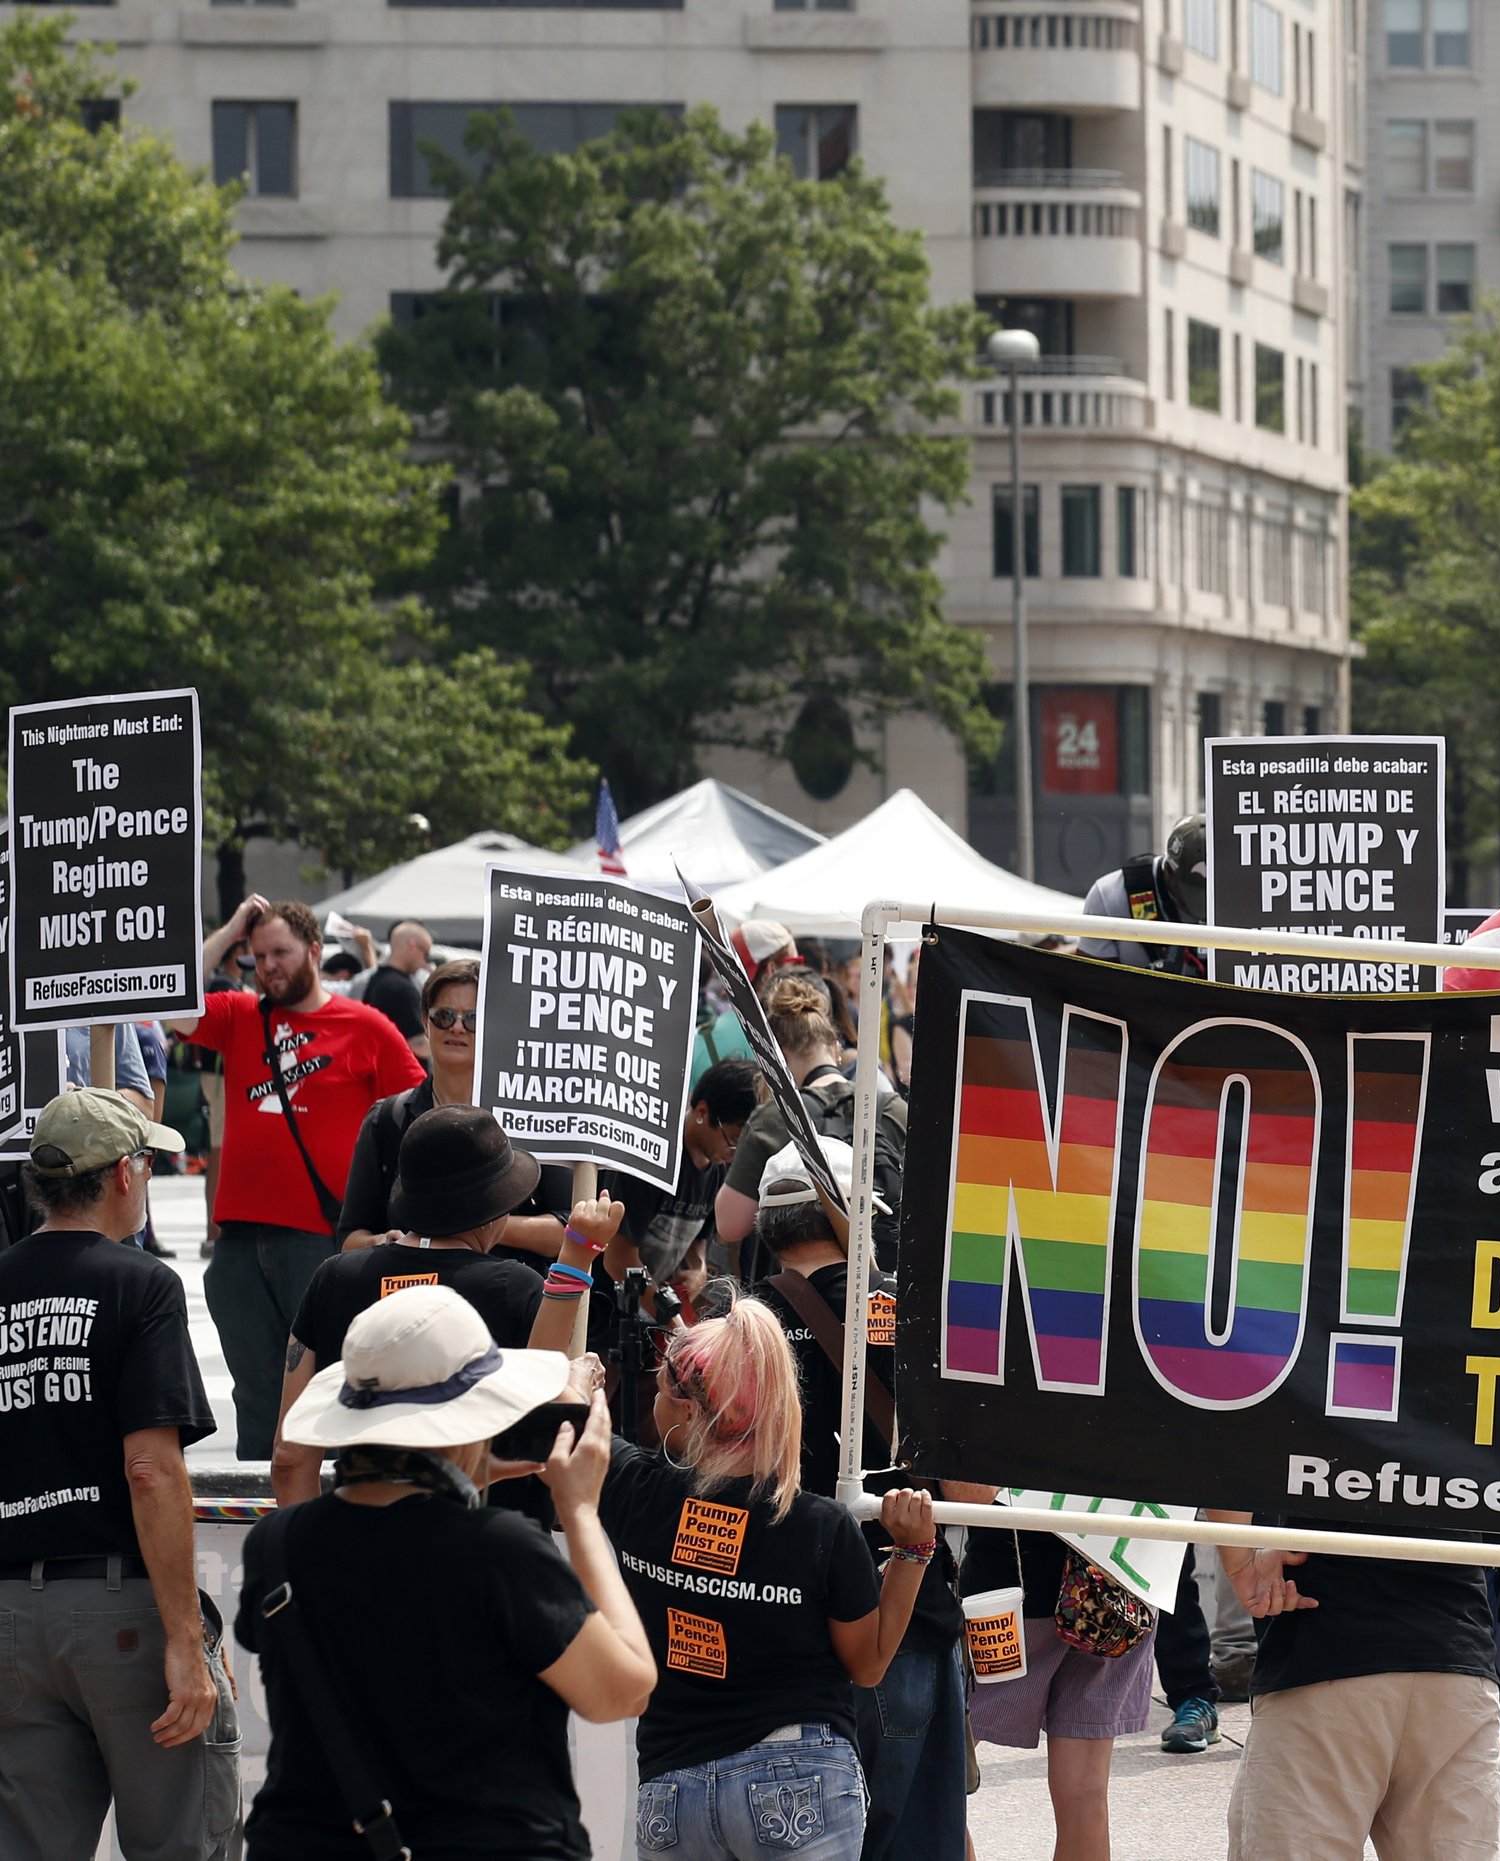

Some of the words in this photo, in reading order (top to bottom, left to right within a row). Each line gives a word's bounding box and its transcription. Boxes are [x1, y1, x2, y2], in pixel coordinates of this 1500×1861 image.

[22, 728, 45, 746] This
[48, 723, 109, 745] Nightmare
[113, 717, 148, 736] Must
[152, 714, 183, 732] End:
[1056, 721, 1100, 753] 24
[72, 758, 119, 792] The
[1222, 759, 1255, 775] Esta
[1259, 757, 1329, 777] pesadilla
[1334, 757, 1369, 773] debe
[1373, 758, 1428, 774] acabar:
[1238, 791, 1265, 814] EL
[1273, 784, 1377, 813] RÉGIMEN
[1385, 790, 1413, 813] DE
[19, 805, 188, 850] Trump/Pence
[1233, 823, 1383, 866] TRUMP
[1396, 829, 1419, 865] Y
[52, 856, 148, 898] Regime
[1261, 870, 1394, 912] PENCE
[500, 884, 532, 902] Esta
[535, 891, 603, 908] pesadilla
[607, 896, 638, 917] debe
[641, 908, 689, 934] acabar:
[40, 910, 107, 950] MUST
[116, 905, 165, 942] GO!
[513, 914, 538, 939] EL
[546, 916, 644, 955] RÉGIMEN
[650, 938, 674, 965] DE
[33, 973, 176, 1001] RefuseFascism.org
[507, 944, 647, 999] TRUMP
[658, 975, 677, 1010] Y
[1234, 963, 1420, 993] MARCHARSE!
[529, 990, 654, 1047] PENCE
[516, 1040, 607, 1073] ¡TIENE
[615, 1051, 661, 1090] QUE
[498, 1071, 669, 1129] MARCHARSE!
[502, 1111, 661, 1161] RefuseFascism.org
[941, 989, 1432, 1422] NO!
[384, 1273, 435, 1290] Trump/
[10, 1297, 99, 1321] NIGHTMARE
[868, 1318, 896, 1329] MUS
[37, 1316, 93, 1347] END!
[870, 1331, 889, 1341] NO!
[53, 1356, 91, 1372] REGIME
[44, 1372, 92, 1402] GO!
[686, 1500, 747, 1525] Trump/
[685, 1516, 737, 1540] Pence
[676, 1548, 698, 1562] NO!
[677, 1533, 714, 1549] MUST
[717, 1541, 739, 1556] GO!
[622, 1551, 802, 1605] REFUSEFASCISM.ORG
[669, 1610, 720, 1633] Trump/
[674, 1624, 719, 1646] Pence
[966, 1612, 1014, 1632] Trump/
[670, 1639, 702, 1654] MUST
[706, 1646, 724, 1660] GO!
[970, 1631, 1014, 1646] Pence
[971, 1648, 998, 1660] MUST
[1002, 1642, 1020, 1656] GO!
[671, 1653, 690, 1667] NO!
